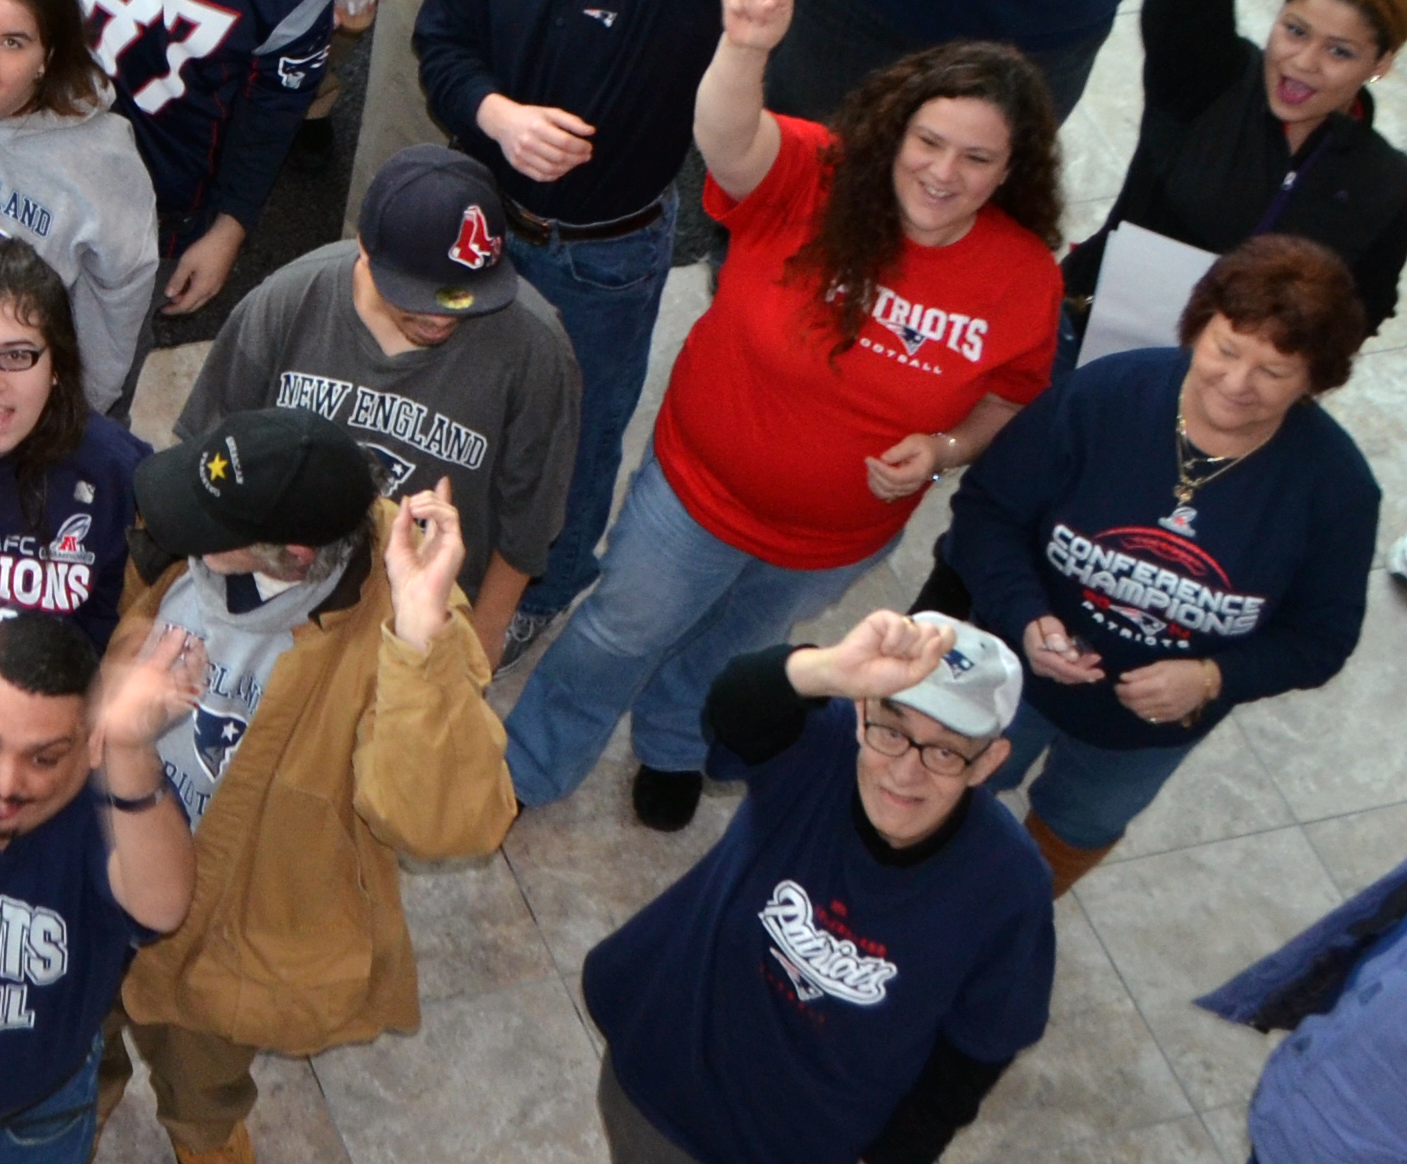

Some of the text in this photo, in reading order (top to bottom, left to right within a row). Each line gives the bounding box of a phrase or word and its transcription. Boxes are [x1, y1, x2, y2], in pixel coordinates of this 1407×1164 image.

[825, 277, 990, 363] TRIOTS
[858, 336, 943, 375] OOTBALL
[276, 369, 488, 470] NEW ENGLAND
[1045, 540, 1260, 637] CHAMPIONS
[1052, 523, 1266, 616] CONFERENCE
[757, 879, 899, 1006] Patriots
